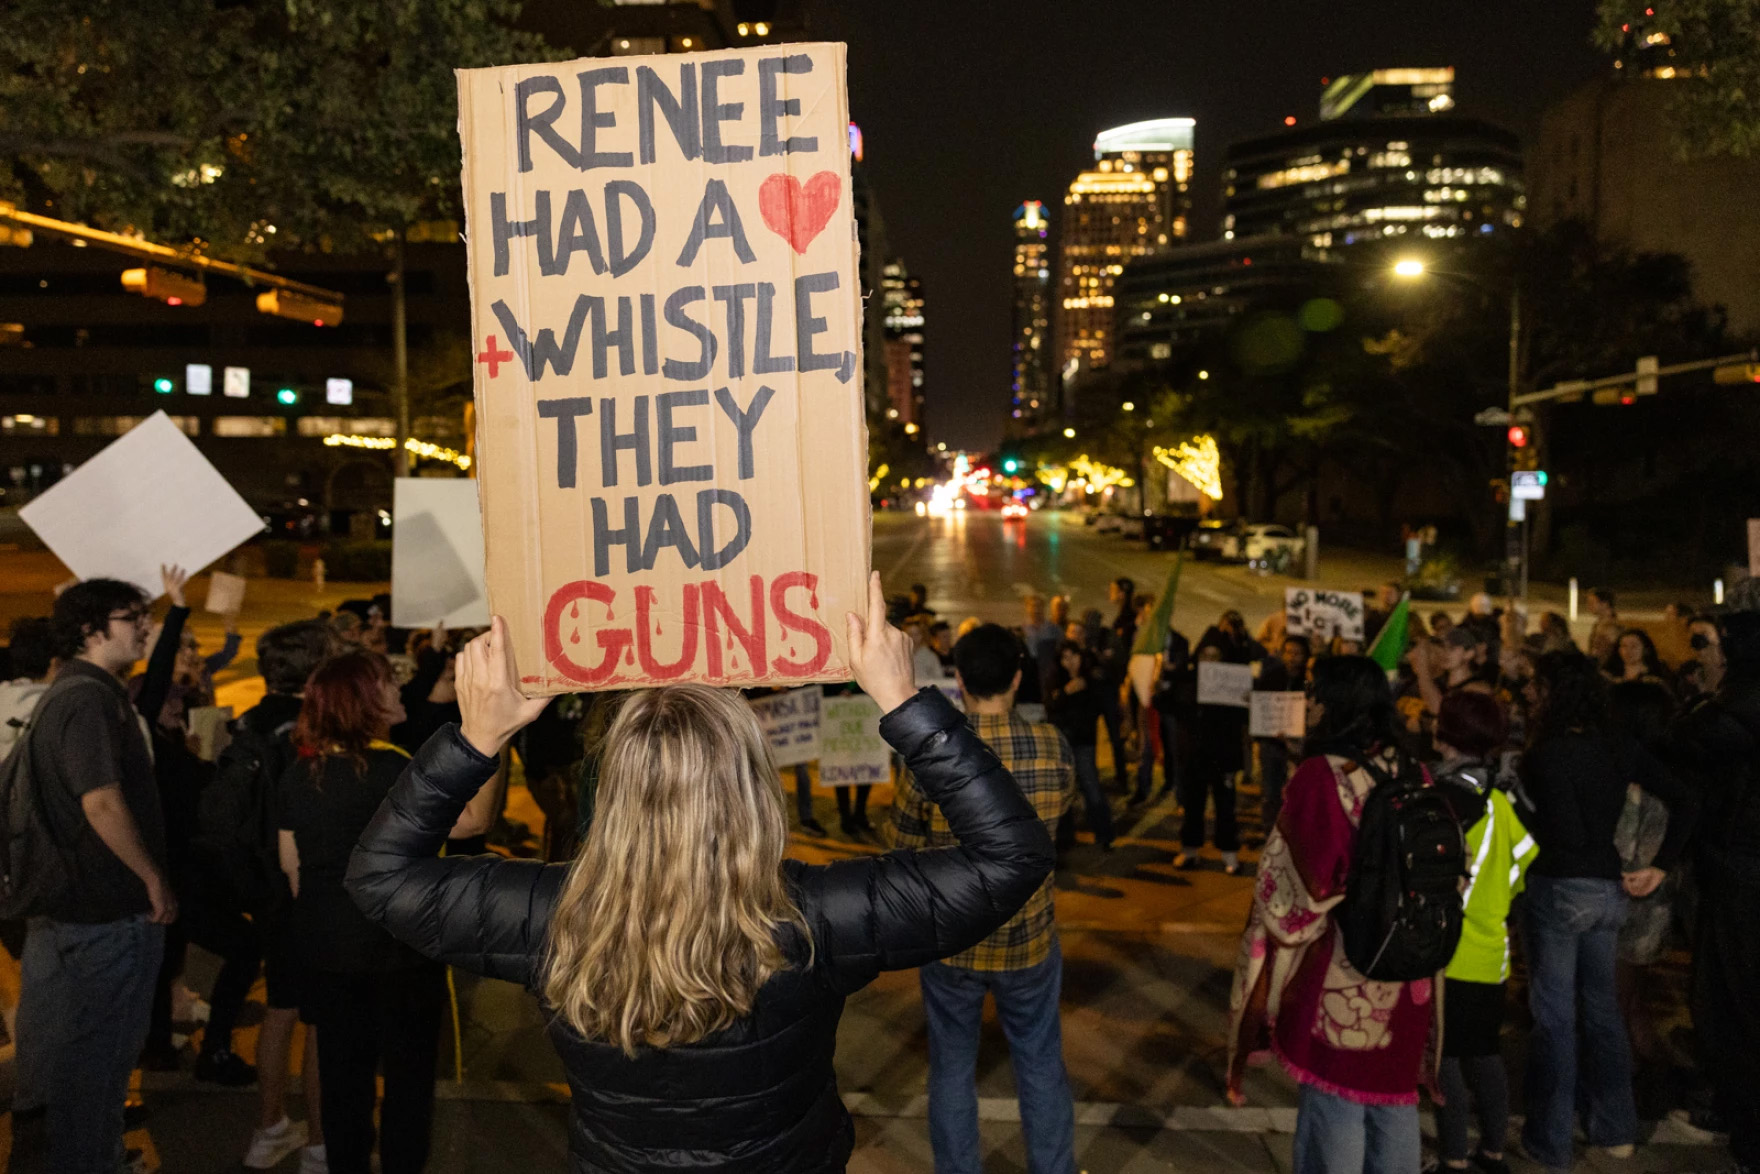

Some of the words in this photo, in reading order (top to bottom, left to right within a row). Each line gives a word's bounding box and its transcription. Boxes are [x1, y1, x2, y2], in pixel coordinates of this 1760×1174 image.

[515, 54, 818, 172] RENEE
[490, 179, 657, 278] HAD
[676, 178, 757, 267] A
[490, 271, 857, 384] WHISTLE,
[537, 385, 776, 489] THEY
[590, 488, 752, 577] HAD
[543, 571, 832, 683] GUNS
